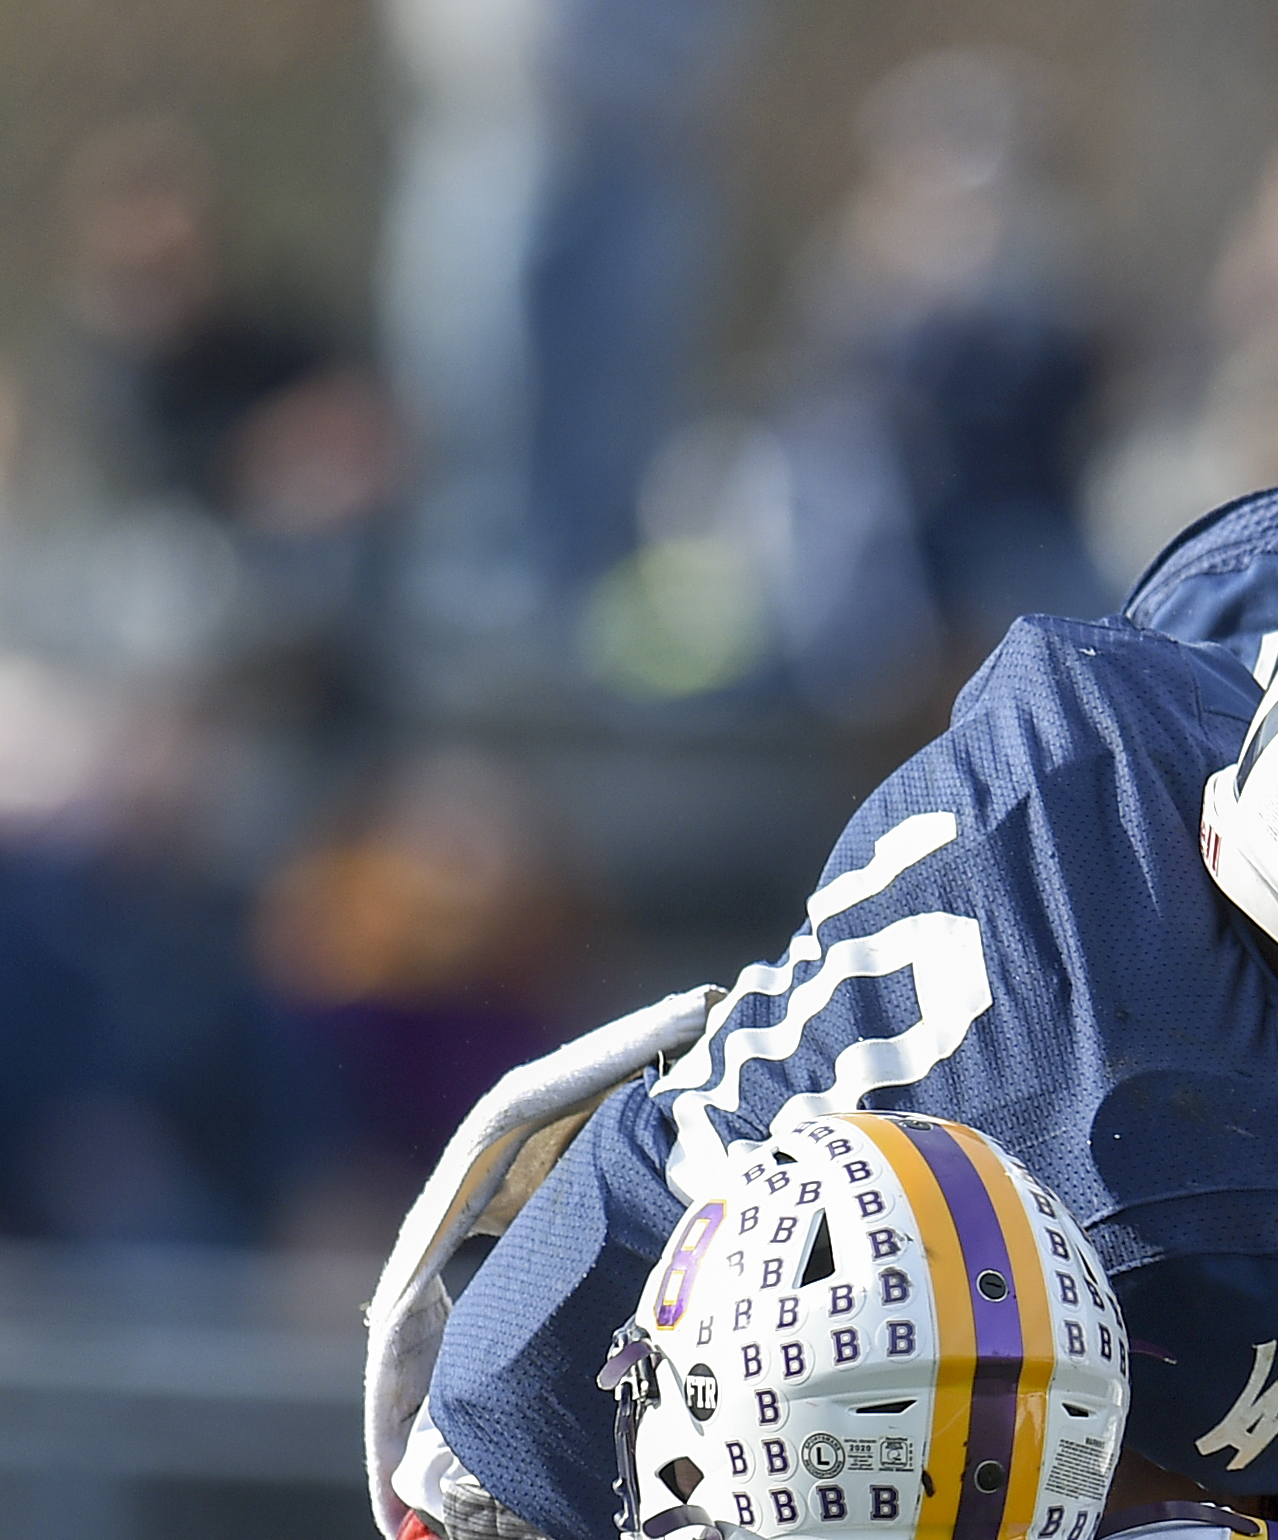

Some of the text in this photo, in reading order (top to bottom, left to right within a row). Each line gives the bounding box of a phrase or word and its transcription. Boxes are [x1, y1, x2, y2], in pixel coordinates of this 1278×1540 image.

[808, 1126, 835, 1143] B
[826, 1138, 853, 1160] B
[742, 1164, 765, 1185] B
[764, 1170, 791, 1195] B
[843, 1160, 874, 1184] B
[796, 1180, 821, 1205] B
[855, 1190, 885, 1218] B
[739, 1205, 759, 1235] B
[770, 1216, 798, 1244] B
[867, 1228, 900, 1259] B
[1045, 1227, 1070, 1261] B
[654, 1199, 727, 1331] 8
[760, 1258, 784, 1291] B
[828, 1284, 855, 1318] B
[879, 1269, 909, 1306] B
[1056, 1270, 1079, 1307] B
[775, 1297, 800, 1331] B
[831, 1326, 861, 1366] B
[886, 1320, 916, 1357] B
[1064, 1320, 1086, 1357] B
[1099, 1322, 1112, 1361] B
[741, 1341, 762, 1381] B
[780, 1340, 806, 1380] B
[685, 1375, 718, 1409] FTR
[755, 1388, 781, 1426] B
[725, 1440, 748, 1477] B
[761, 1438, 790, 1476] B
[816, 1447, 829, 1465] L
[849, 1444, 872, 1452] 2020
[732, 1491, 755, 1528] B
[769, 1487, 799, 1526] B
[816, 1485, 847, 1522] B
[870, 1485, 900, 1521] B
[1038, 1505, 1065, 1539] B
